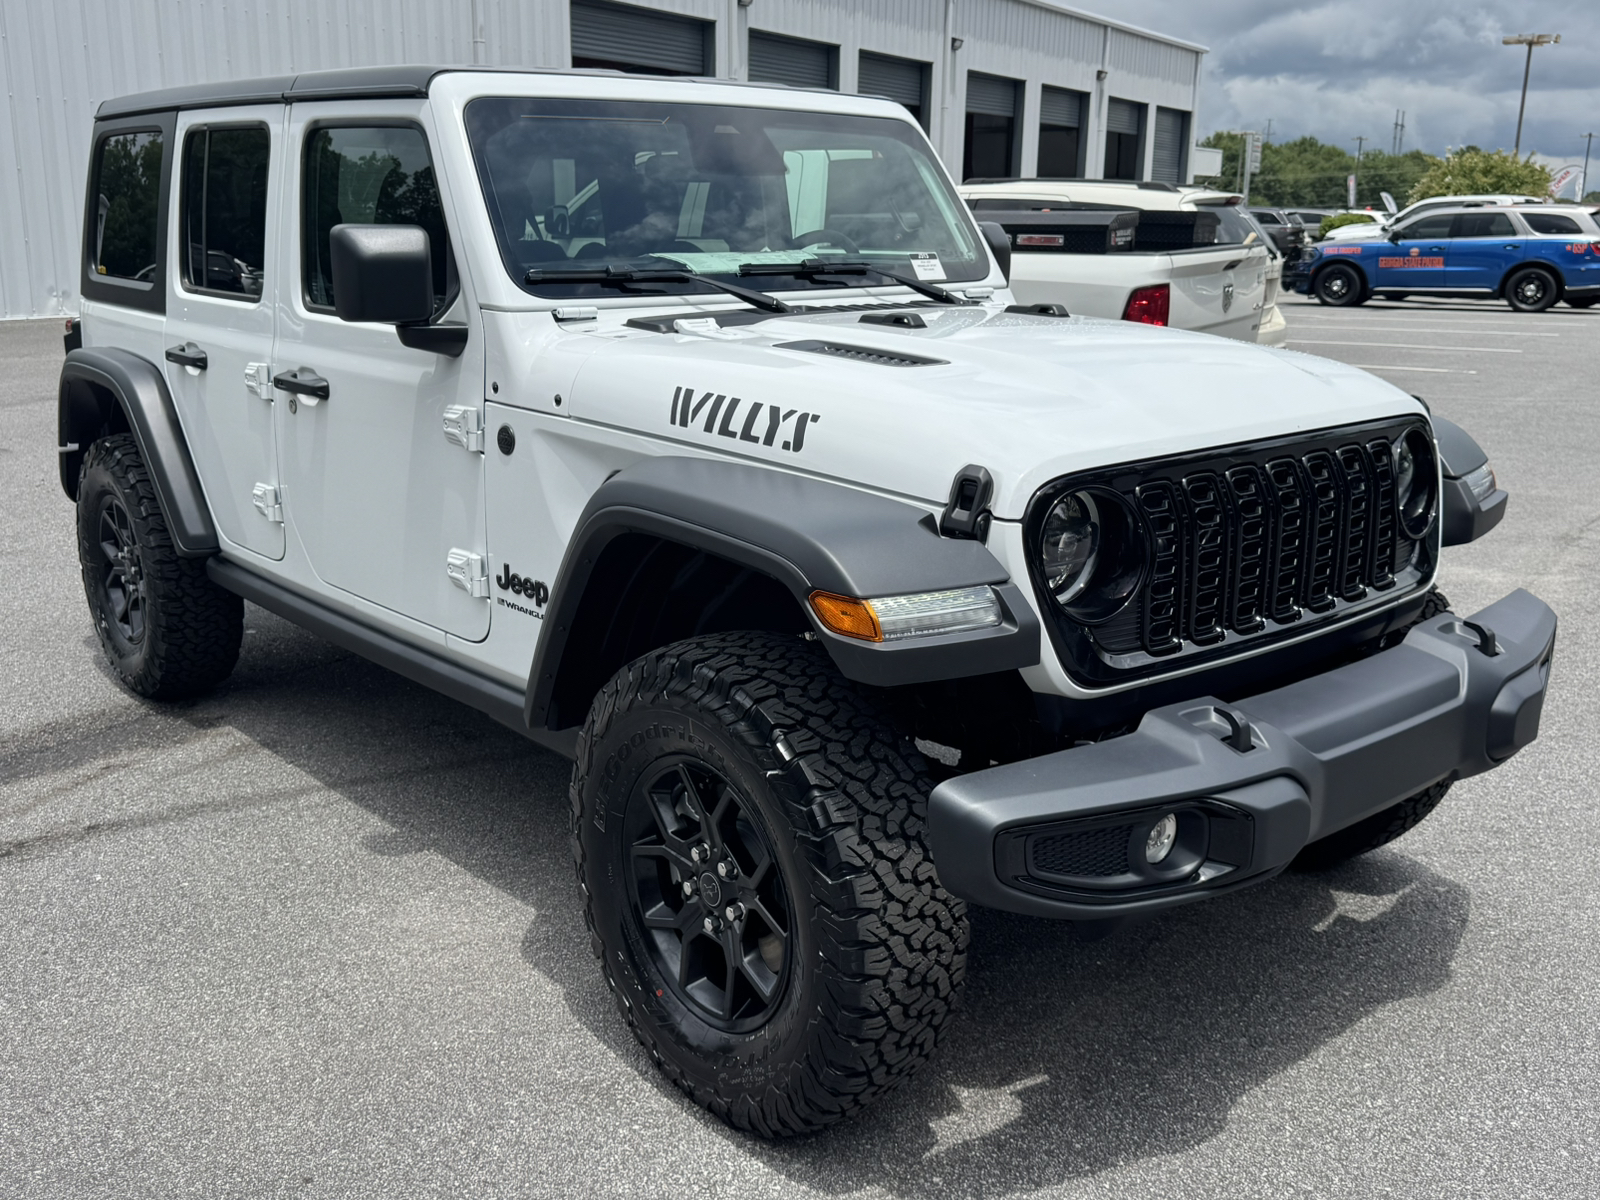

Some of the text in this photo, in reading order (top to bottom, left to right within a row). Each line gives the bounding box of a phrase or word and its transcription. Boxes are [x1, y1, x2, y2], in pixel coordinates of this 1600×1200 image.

[1378, 256, 1444, 268] GEORGIA STATE PATROL
[669, 385, 821, 453] WILLYS
[496, 562, 549, 608] Jeep
[593, 721, 725, 834] BFGoodrich
